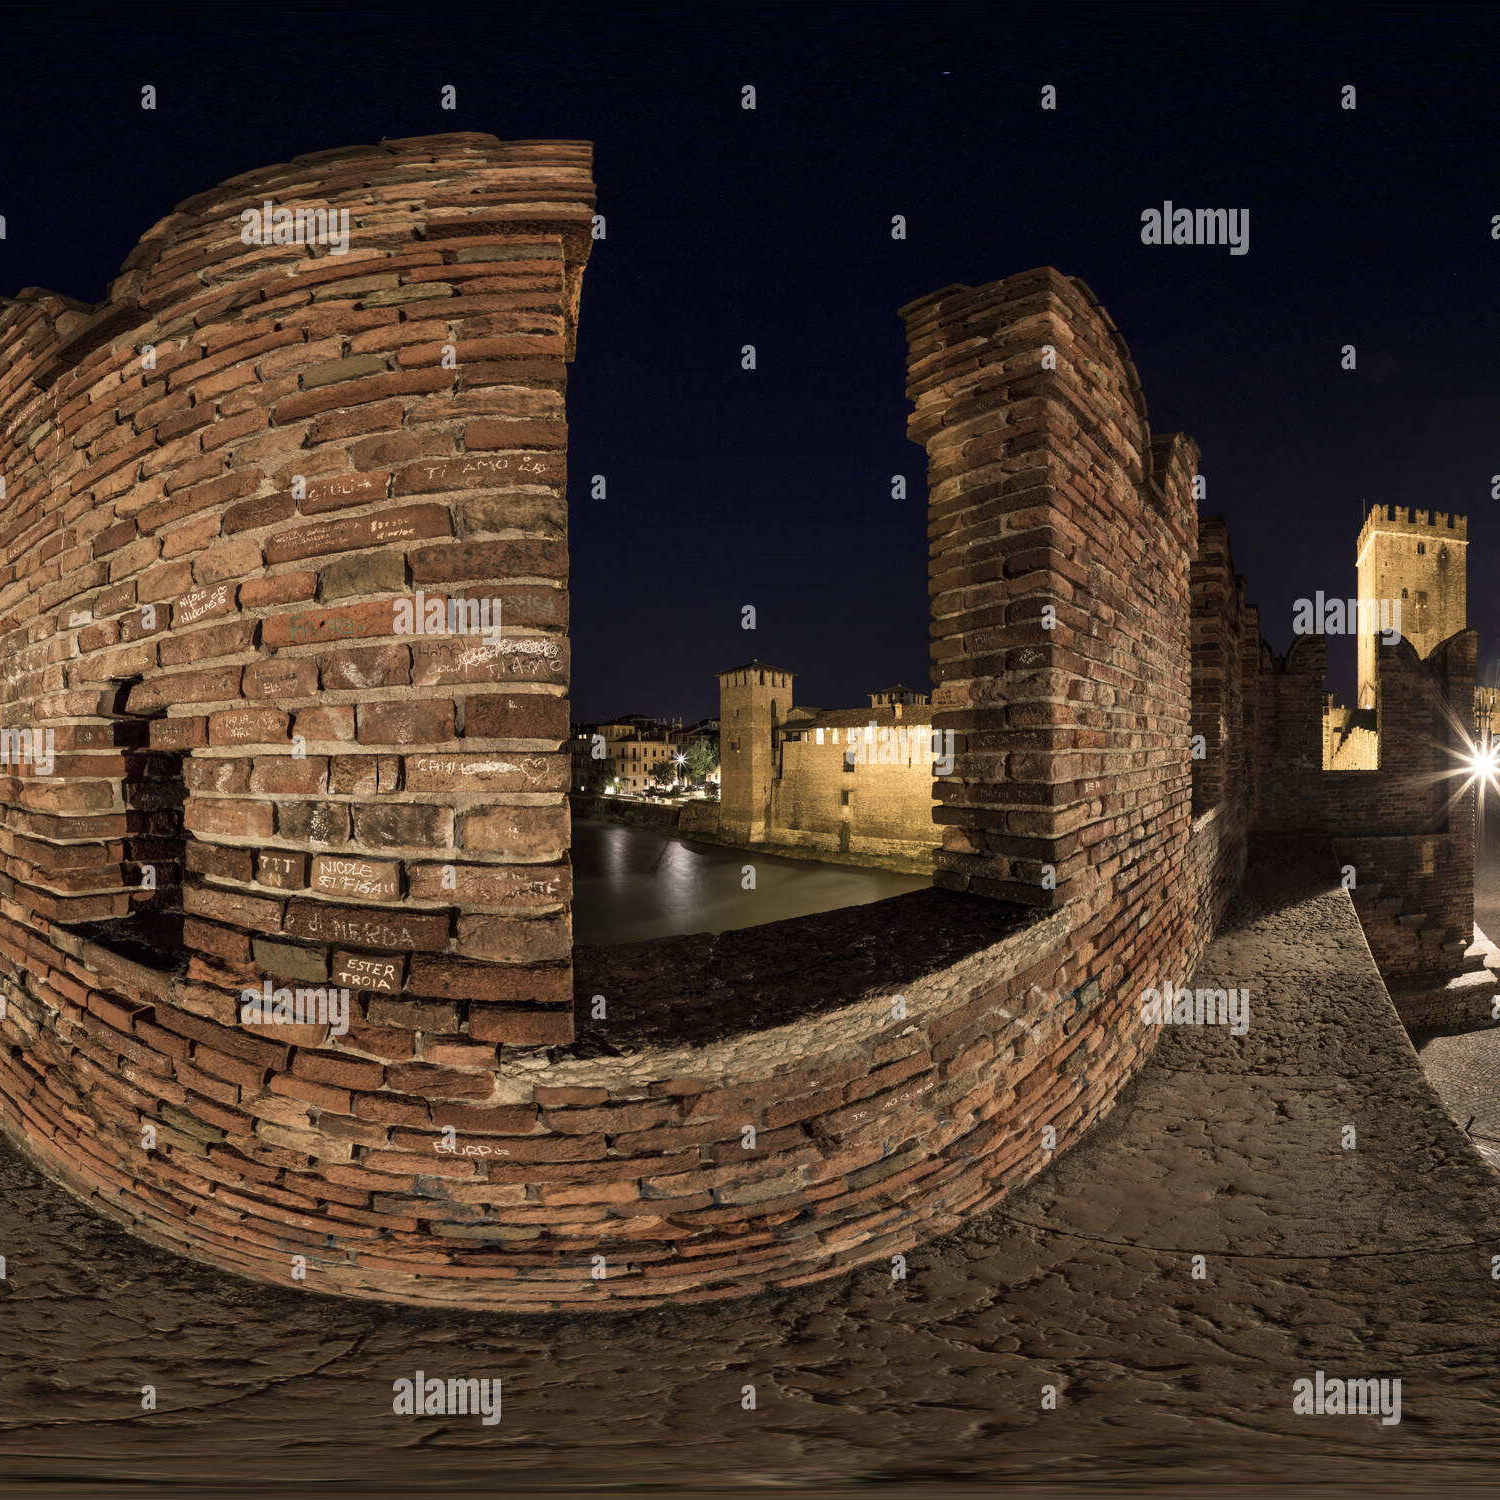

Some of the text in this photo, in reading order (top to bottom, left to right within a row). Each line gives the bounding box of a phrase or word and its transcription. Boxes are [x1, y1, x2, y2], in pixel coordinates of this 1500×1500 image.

[320, 861, 373, 878] NICOLE
[347, 959, 395, 981] ESTER
[338, 972, 391, 990] TROIA
